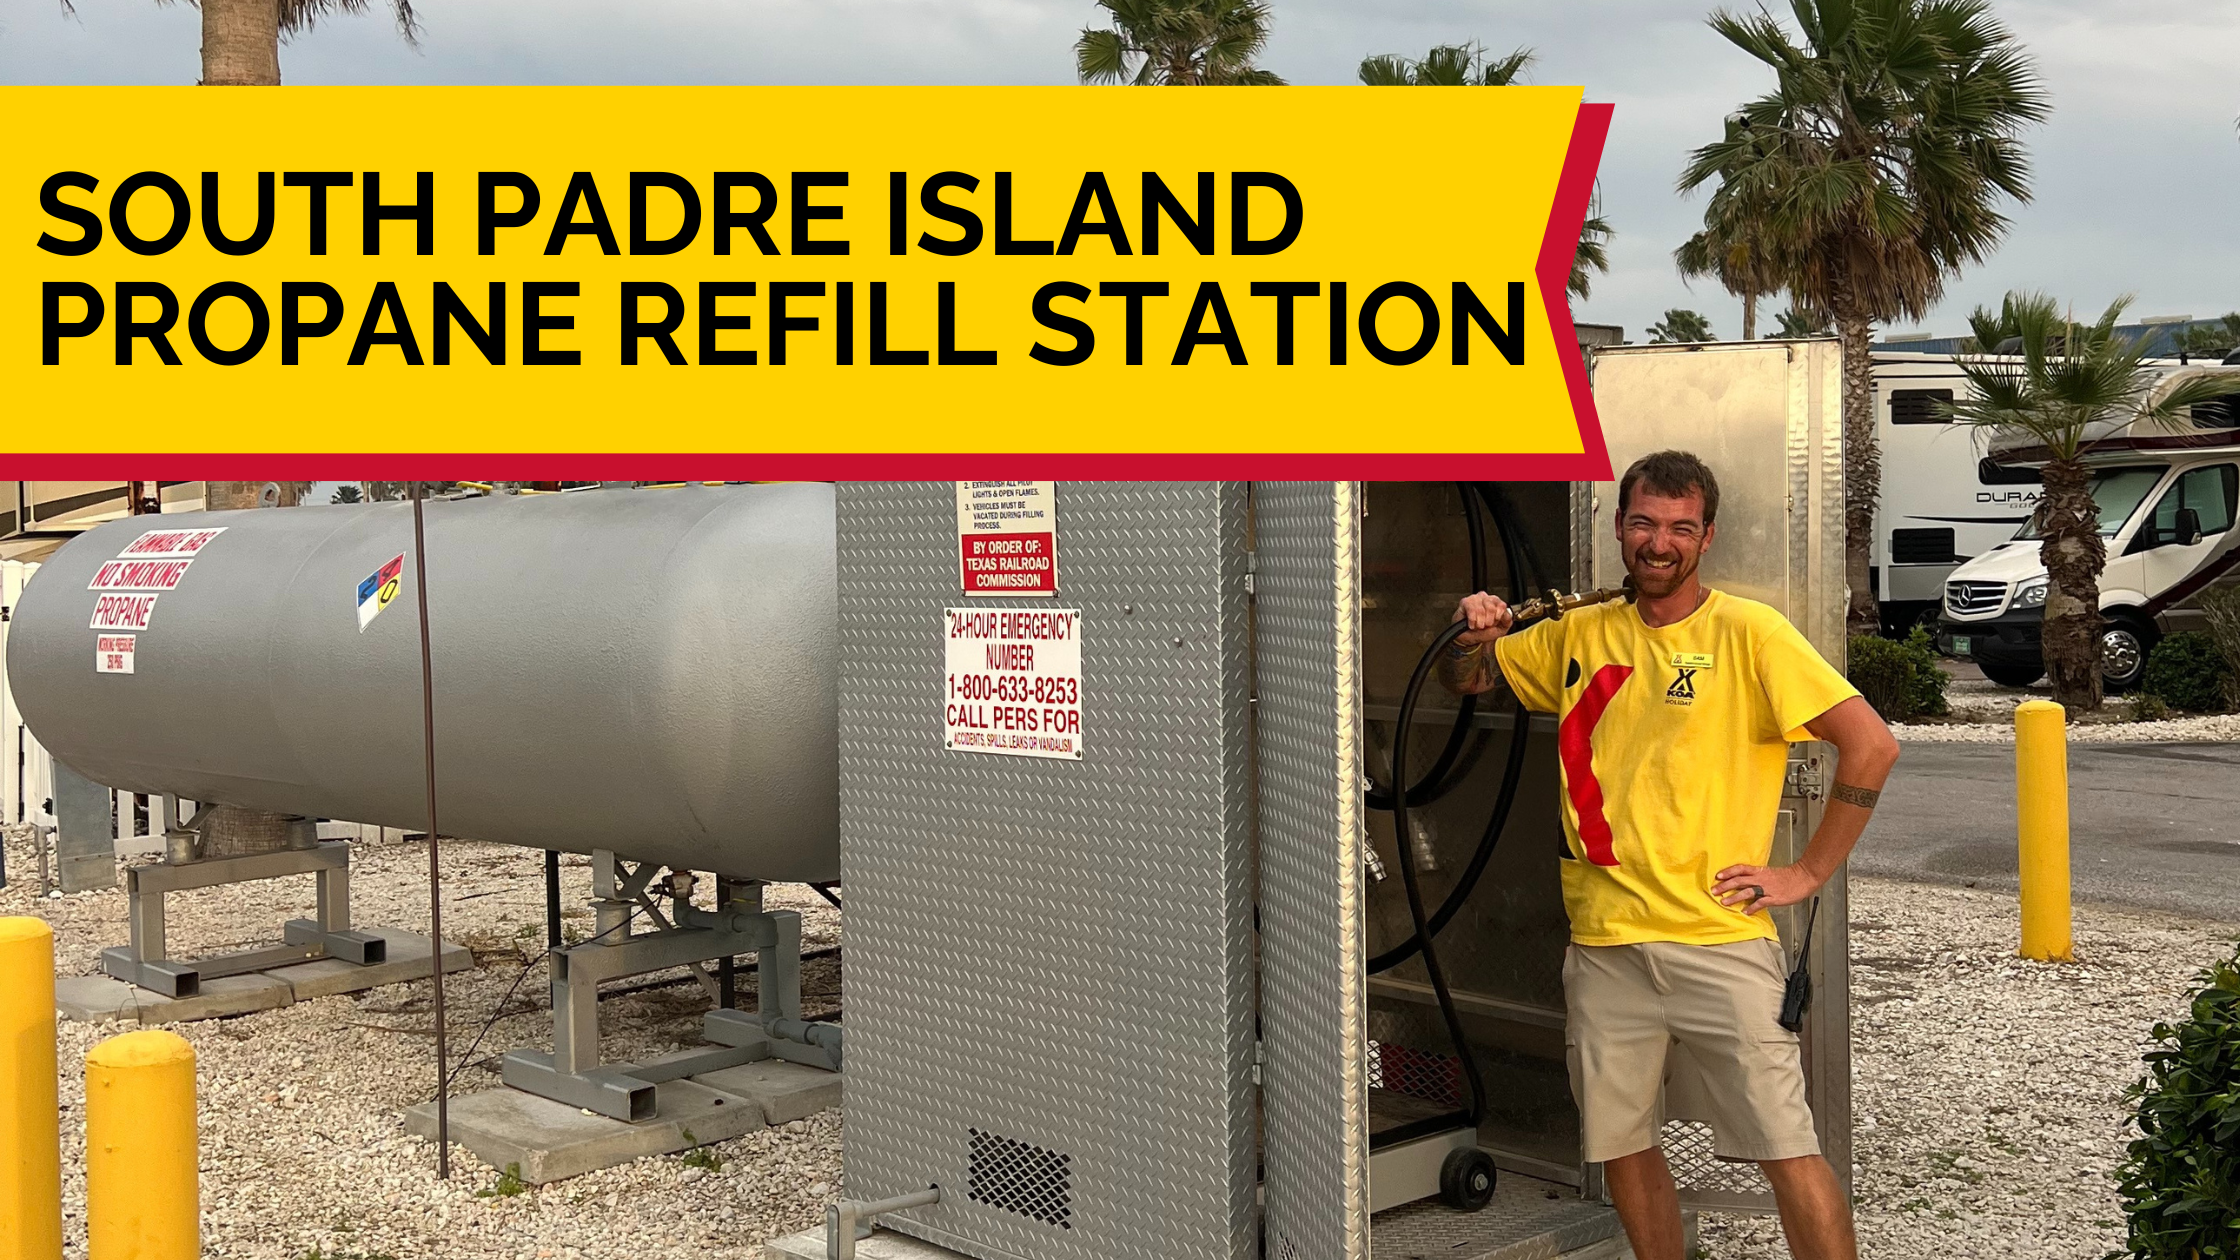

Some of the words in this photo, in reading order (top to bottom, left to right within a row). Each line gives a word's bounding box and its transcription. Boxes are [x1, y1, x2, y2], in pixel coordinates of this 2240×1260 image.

[973, 490, 992, 498] LIGHTS
[993, 490, 997, 498] &
[998, 489, 1014, 497] OPEN
[1015, 488, 1040, 496] FLAMES.
[973, 502, 999, 510] VEHICLES
[1001, 501, 1016, 509] MUST
[1018, 501, 1025, 509] BE
[973, 511, 998, 520] VACATED
[999, 511, 1021, 519] DURING
[1022, 510, 1044, 518] FILLING
[974, 521, 1001, 529] PROCESS.
[973, 541, 986, 554] BY
[988, 540, 1023, 554] ORDER
[1025, 540, 1042, 553] OF:
[92, 562, 122, 587] NO
[113, 562, 189, 587] SMOKING
[966, 557, 997, 571] TEXAS
[999, 557, 1050, 571] RAILROAD
[360, 575, 377, 600] 2
[380, 579, 398, 603] 0
[976, 573, 1041, 587] COMMISSION
[92, 596, 155, 626] PROPANE
[951, 612, 997, 639] 24-HOUR
[1001, 612, 1073, 640] EMERGENCY
[986, 644, 1034, 671] NUMBER
[949, 673, 1078, 704] 1-800-633-8253
[1667, 690, 1694, 699] KOA
[947, 704, 988, 728] CALL
[993, 706, 1038, 731] PERS
[1043, 708, 1080, 734] FOR
[954, 731, 986, 748] ACCIDENTS,
[1009, 735, 1028, 749] LEAKS
[1029, 736, 1038, 750] OR
[1039, 737, 1073, 753] VANDALISM
